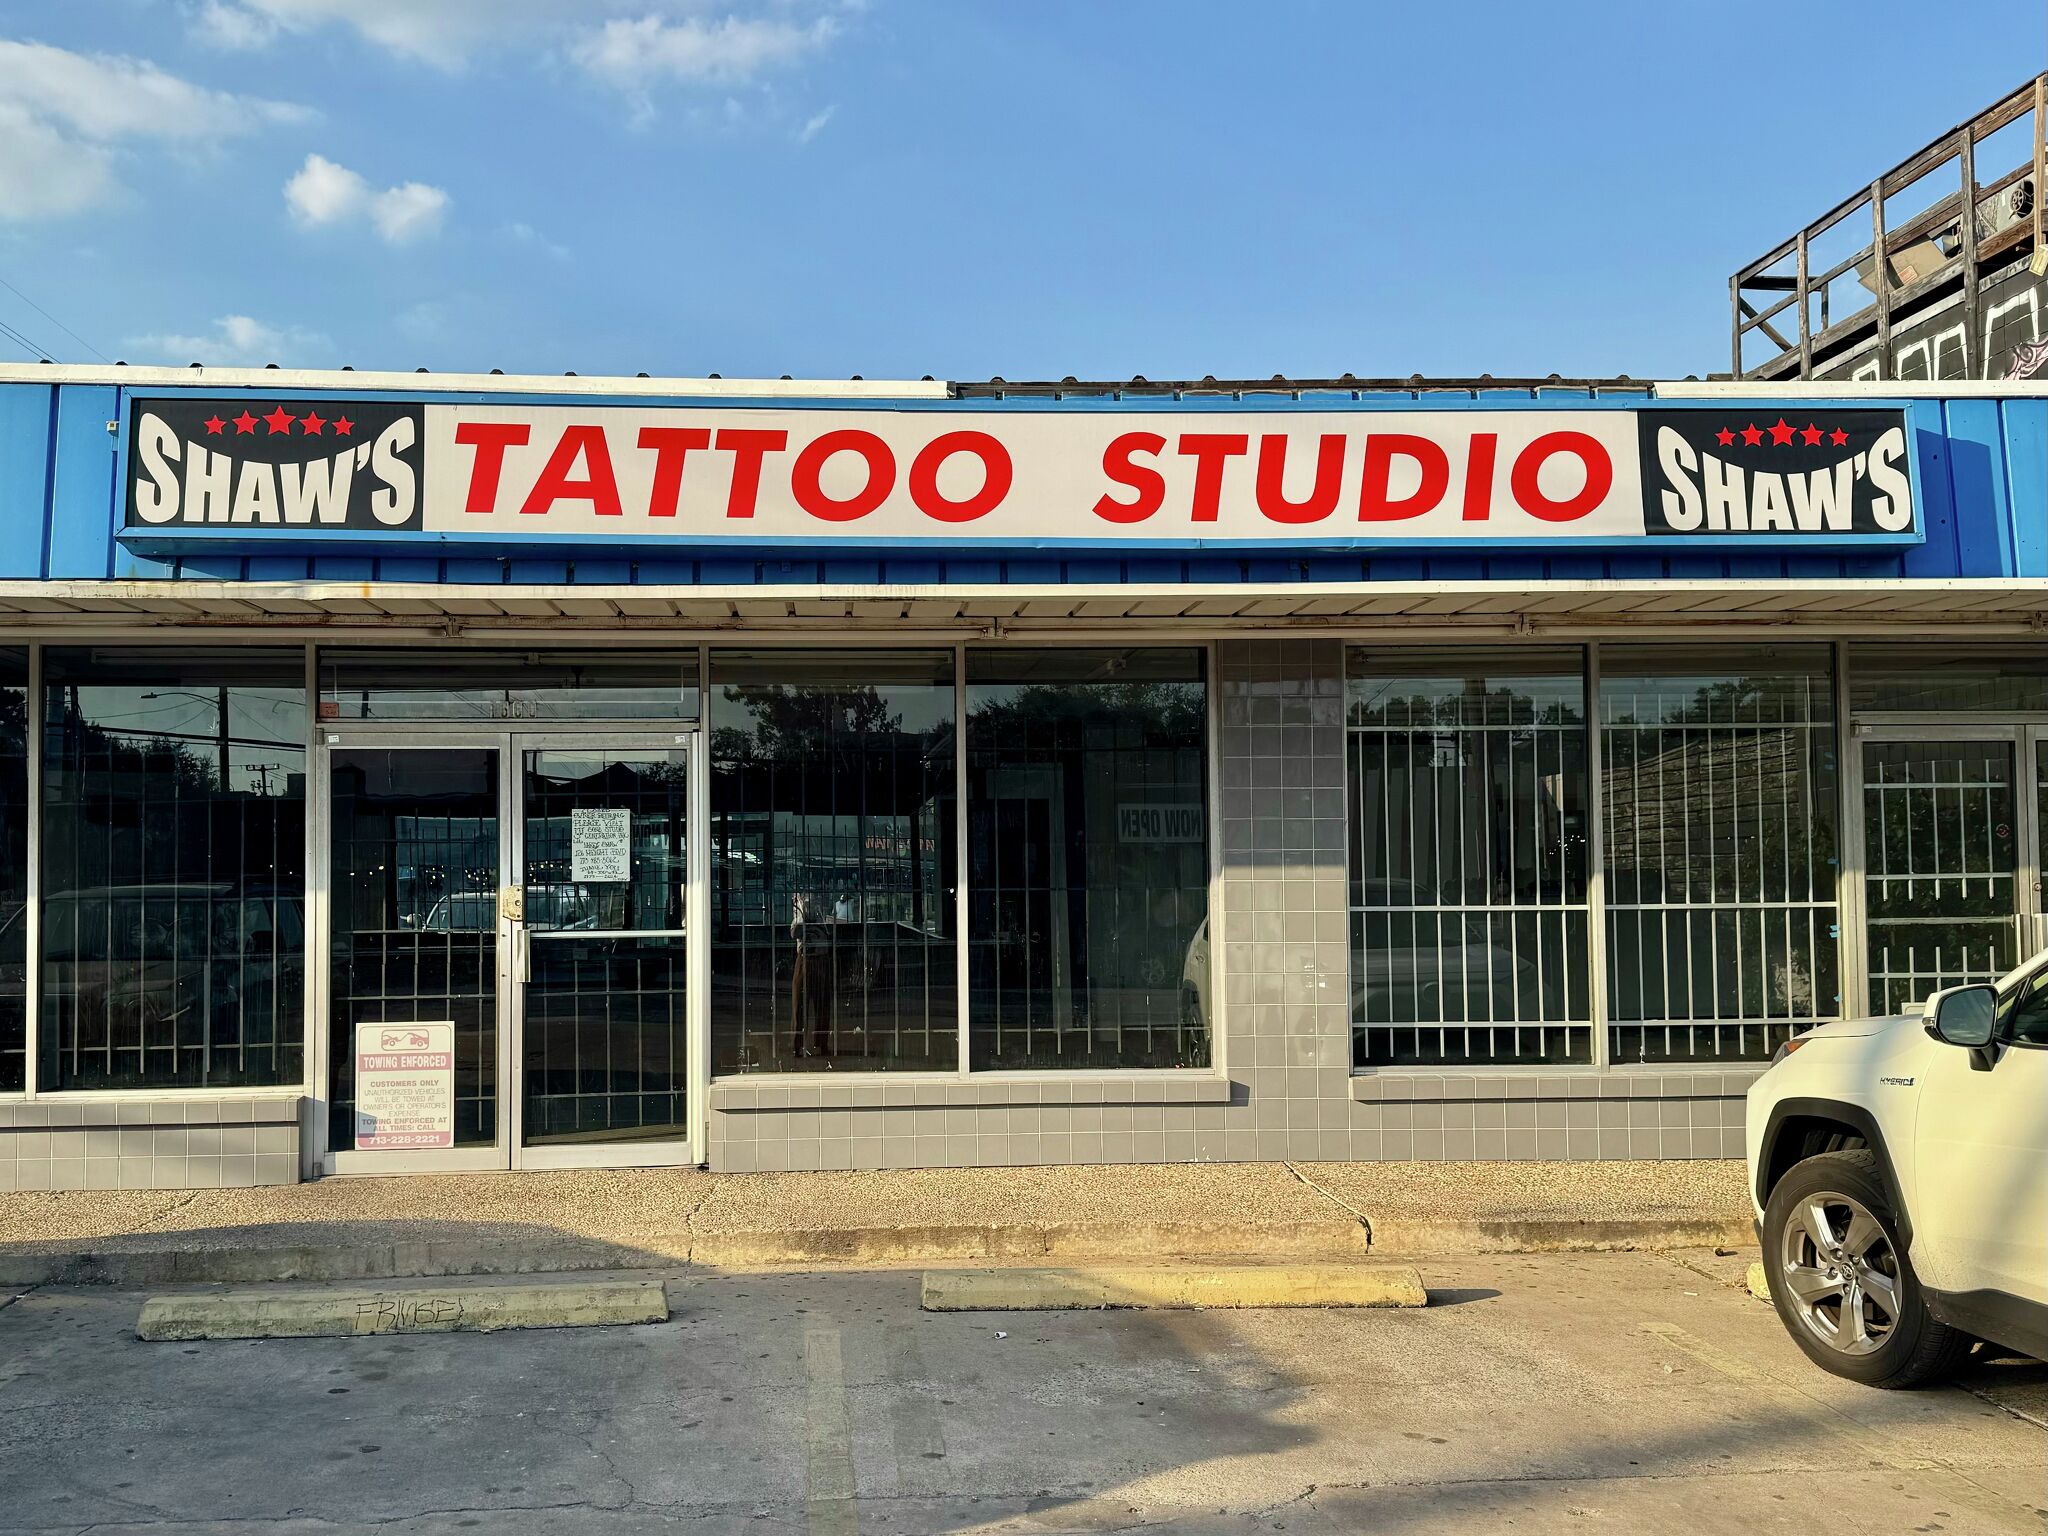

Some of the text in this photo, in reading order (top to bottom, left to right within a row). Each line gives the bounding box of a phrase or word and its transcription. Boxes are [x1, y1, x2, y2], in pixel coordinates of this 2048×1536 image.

[135, 412, 416, 525] SHAW'S
[455, 422, 1613, 524] TATTOO STUDIO
[1657, 425, 1911, 532] SHAW'S
[363, 1055, 447, 1069] TOWING ENFORCED
[370, 1079, 439, 1088] CUSTOMERS ONLY
[364, 1087, 446, 1097] UNAUTHORIZED VEHICLES
[403, 1095, 426, 1103] TOWED
[362, 1116, 448, 1126] TOWING ENFORCED AT
[369, 1135, 440, 1145] 713-228-2221
